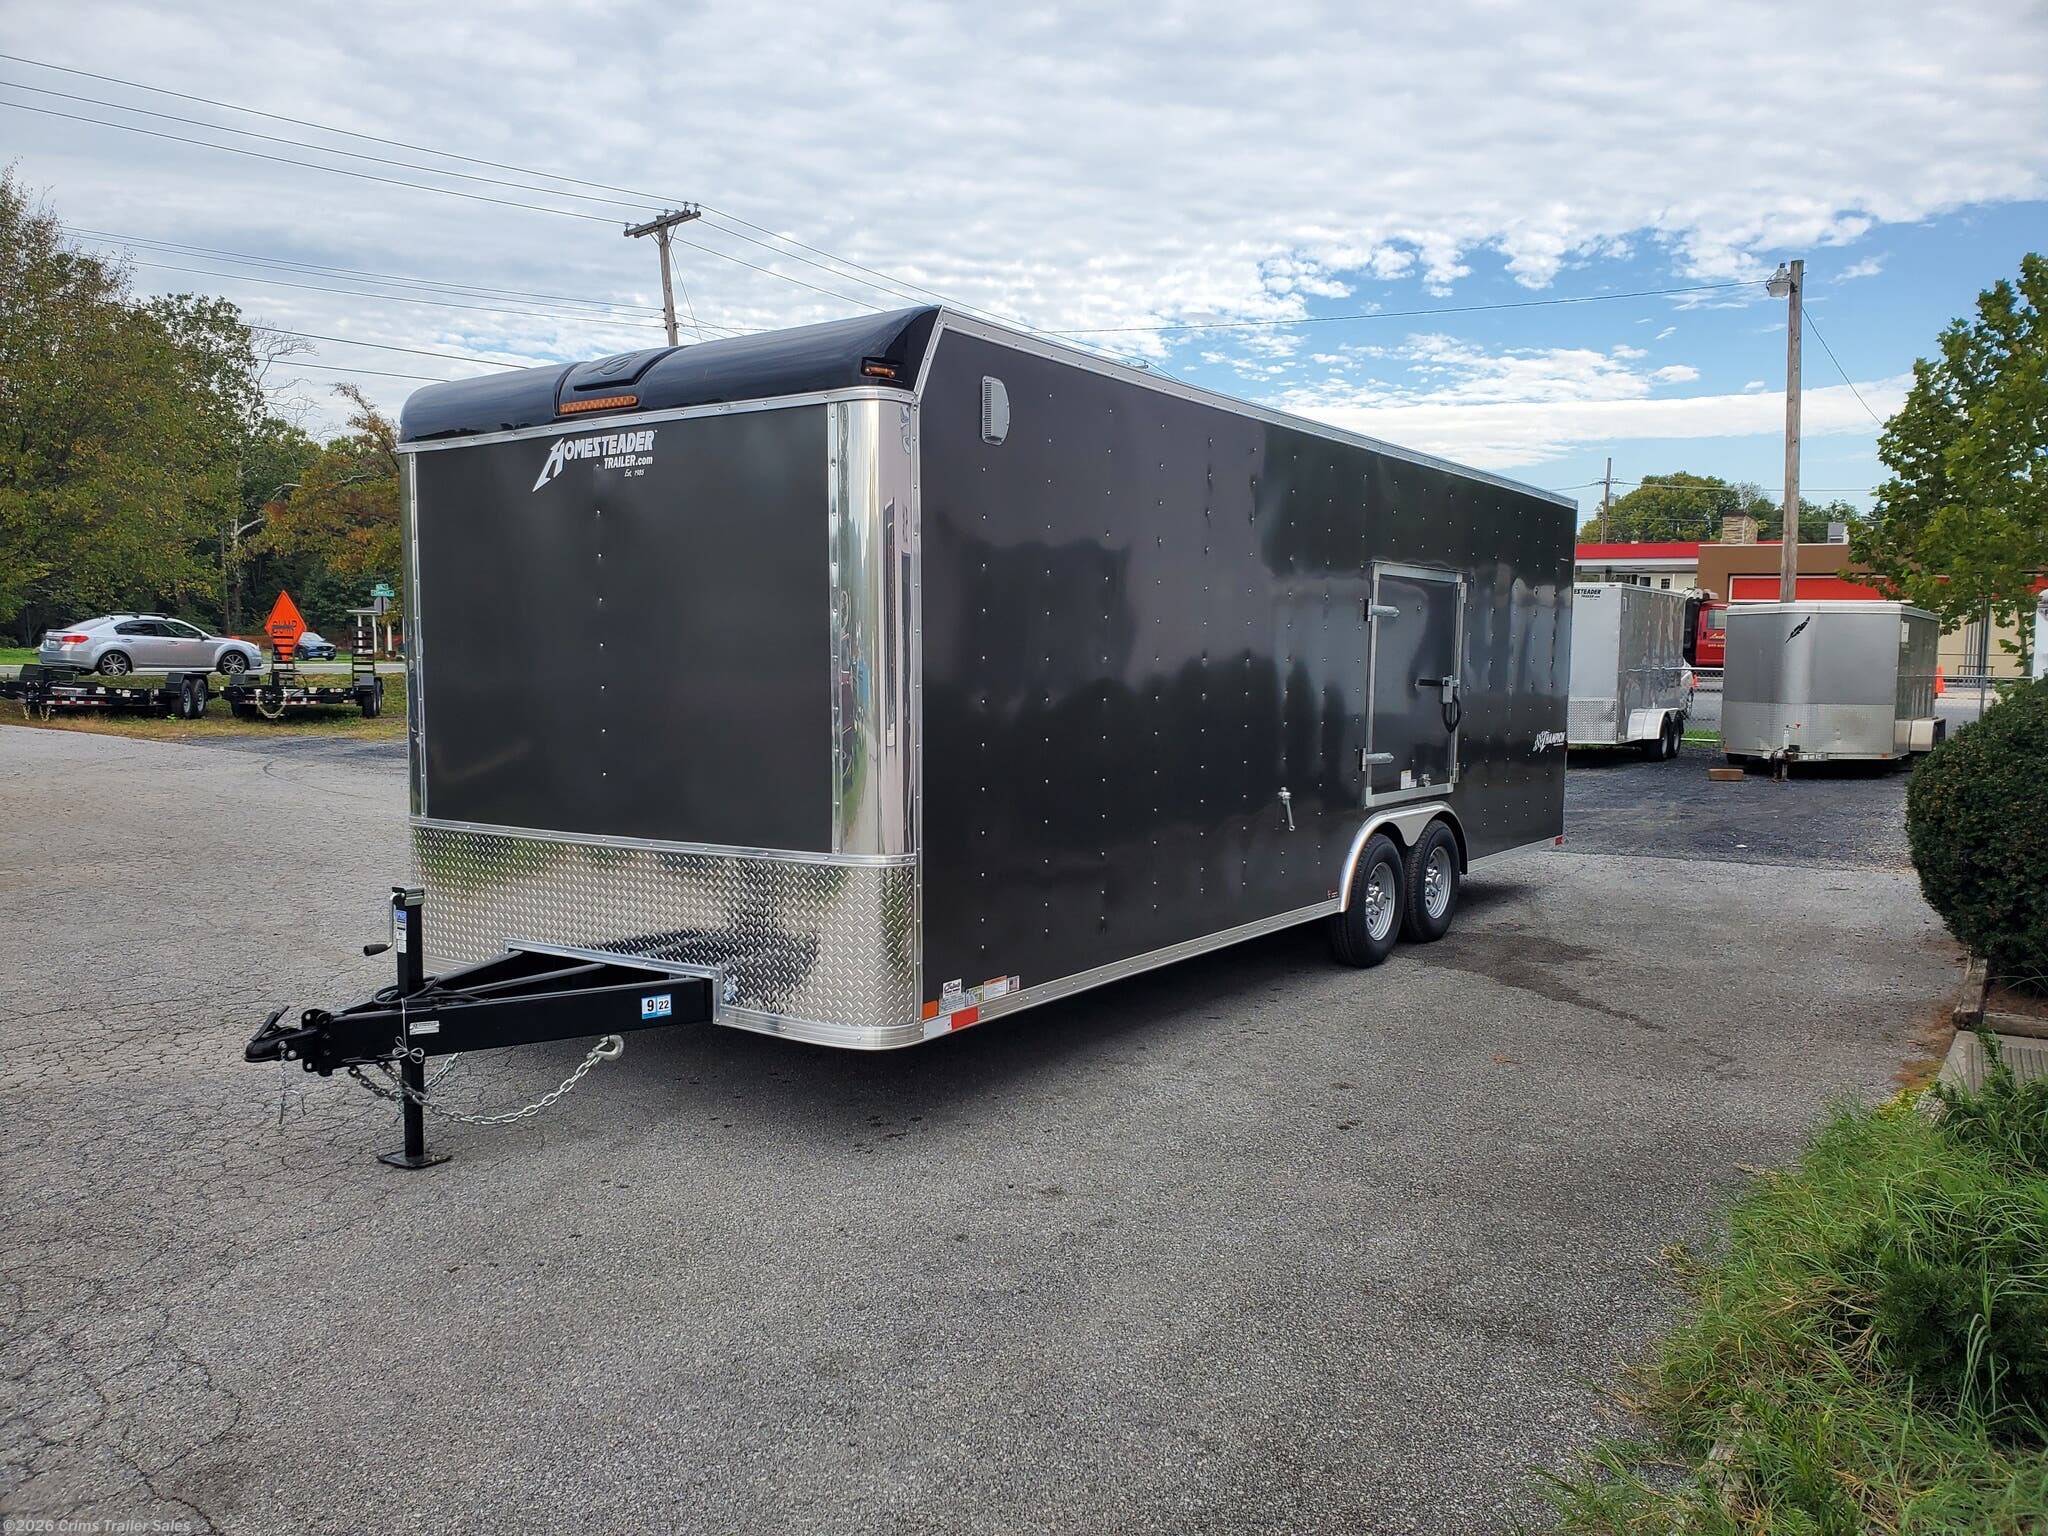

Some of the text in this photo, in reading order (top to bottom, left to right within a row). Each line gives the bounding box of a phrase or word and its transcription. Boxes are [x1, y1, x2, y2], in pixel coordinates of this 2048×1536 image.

[532, 430, 655, 492] HOMESTEADER
[604, 455, 653, 469] TRAILER.com
[647, 999, 669, 1012] 9 22
